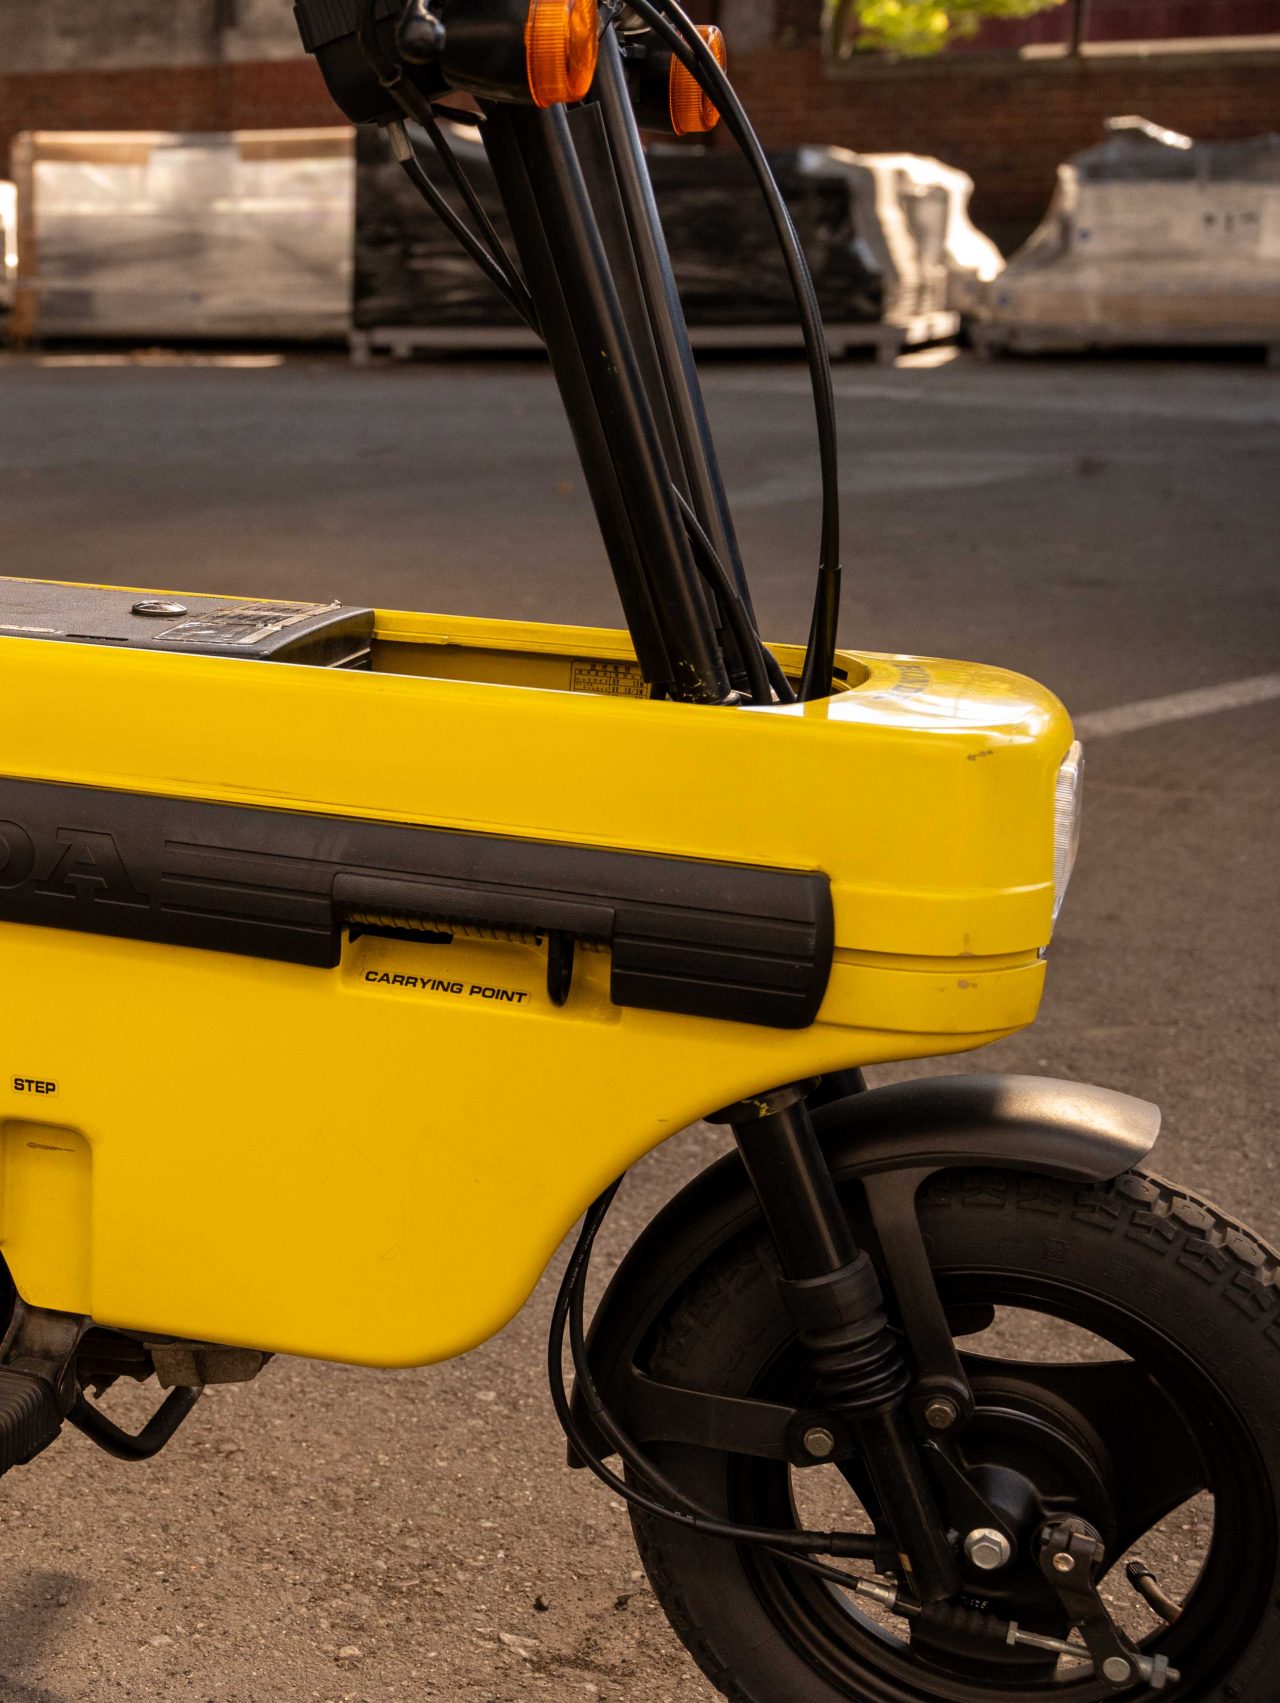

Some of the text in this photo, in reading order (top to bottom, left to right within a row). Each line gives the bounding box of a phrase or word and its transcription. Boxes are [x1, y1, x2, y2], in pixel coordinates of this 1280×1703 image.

[365, 970, 527, 1003] CARRYING POINT
[14, 1078, 56, 1095] STEP
